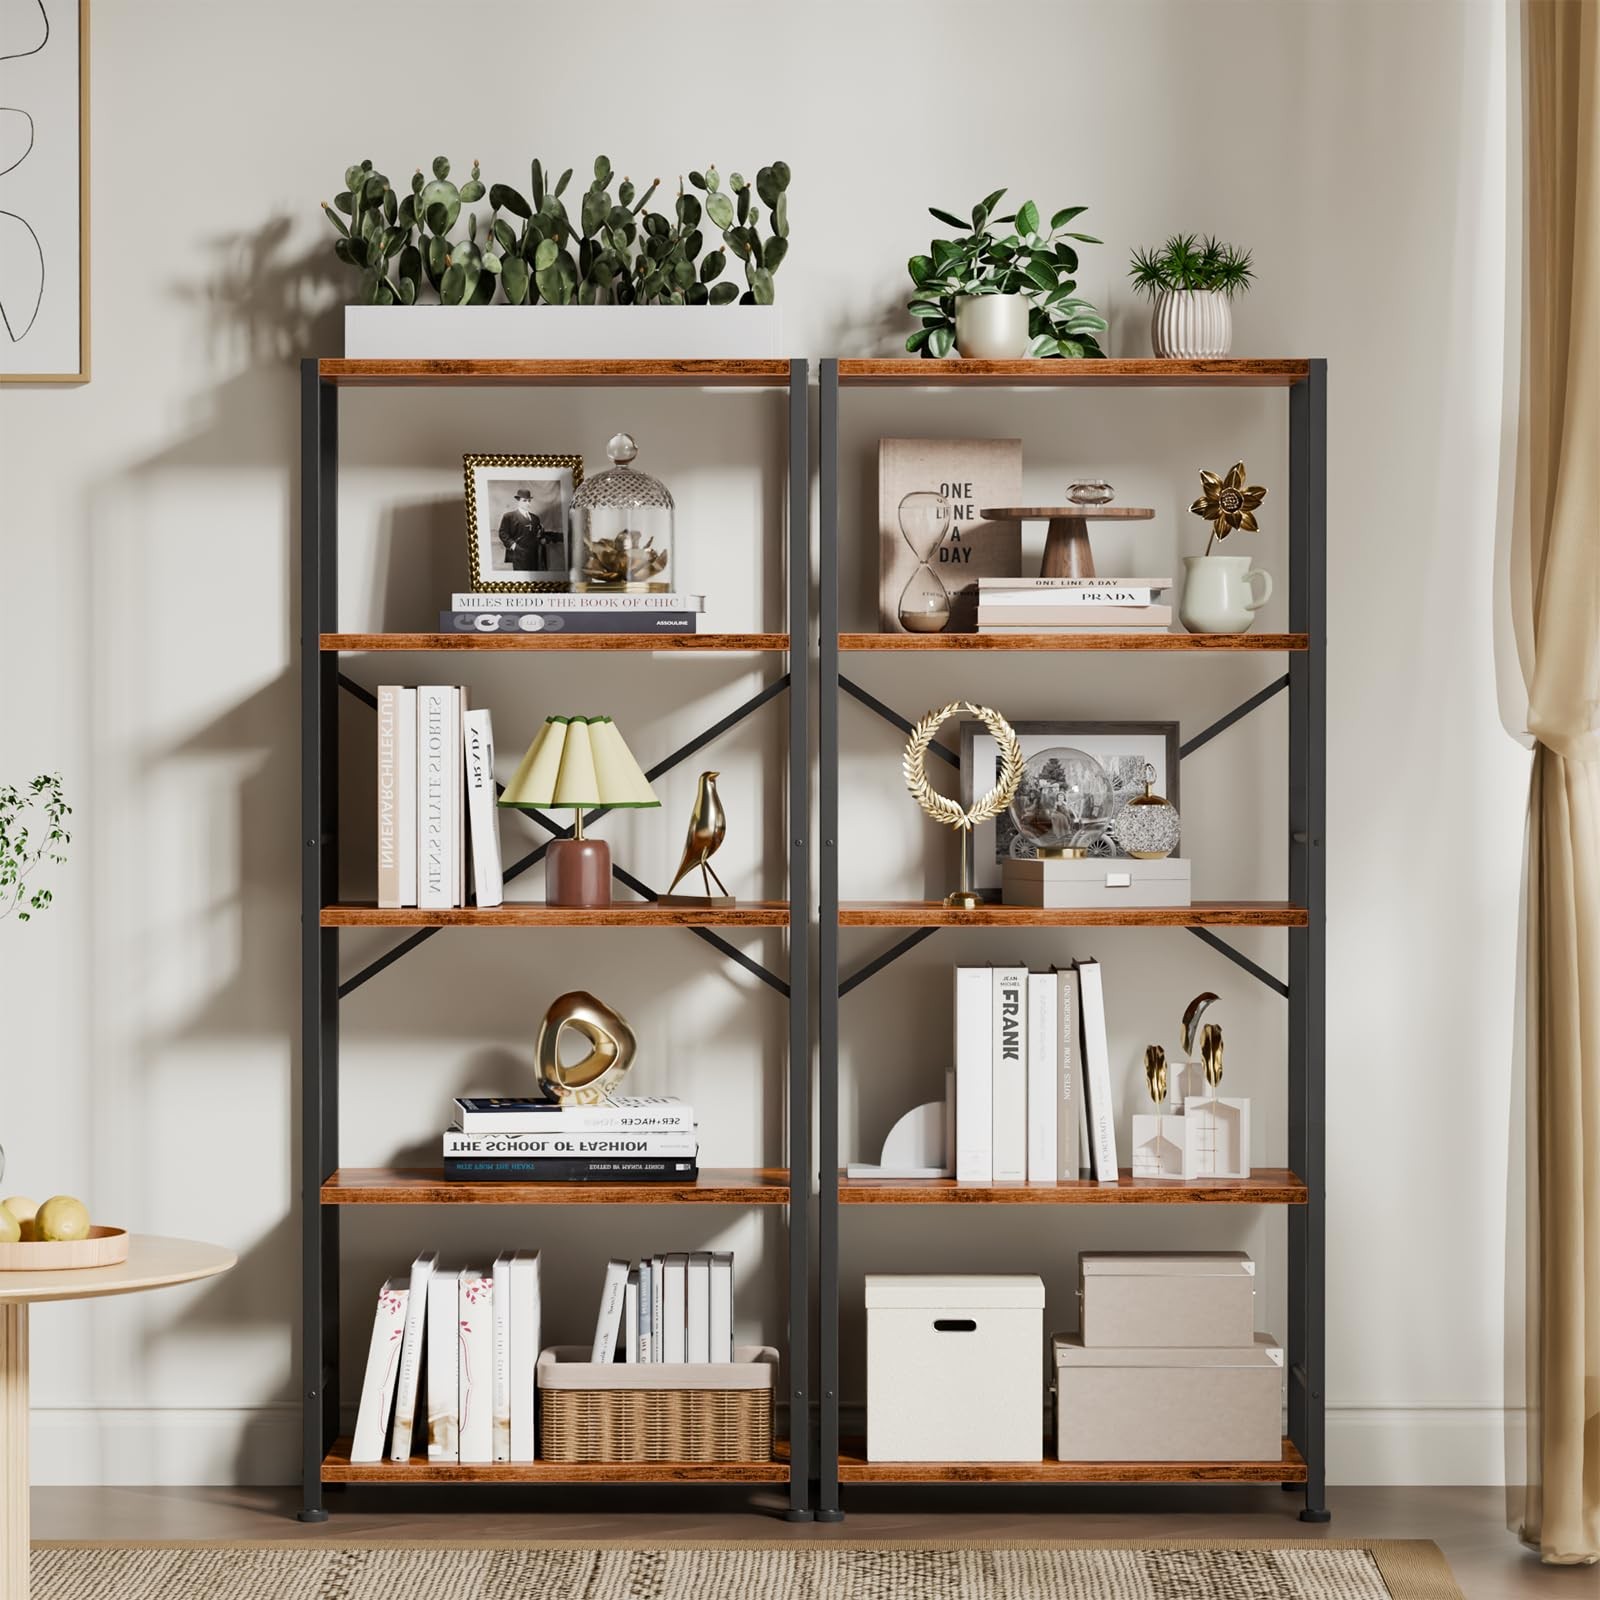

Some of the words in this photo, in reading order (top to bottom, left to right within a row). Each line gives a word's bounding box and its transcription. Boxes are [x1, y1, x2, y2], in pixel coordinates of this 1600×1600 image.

[940, 482, 973, 499] ONE
[950, 526, 961, 542] A
[939, 547, 972, 564] DAY
[459, 598, 502, 608] MILES
[506, 598, 544, 608] REDD
[549, 598, 576, 608] THE
[580, 598, 618, 608] BOOK
[622, 598, 641, 608] OF
[644, 598, 679, 608] CHIC
[1082, 593, 1136, 601] PRADA
[1063, 984, 1071, 1043] UNDERGROUND
[1002, 989, 1019, 1060] FRANK
[1063, 1047, 1071, 1069] FROM
[1063, 1073, 1071, 1100] NOTES
